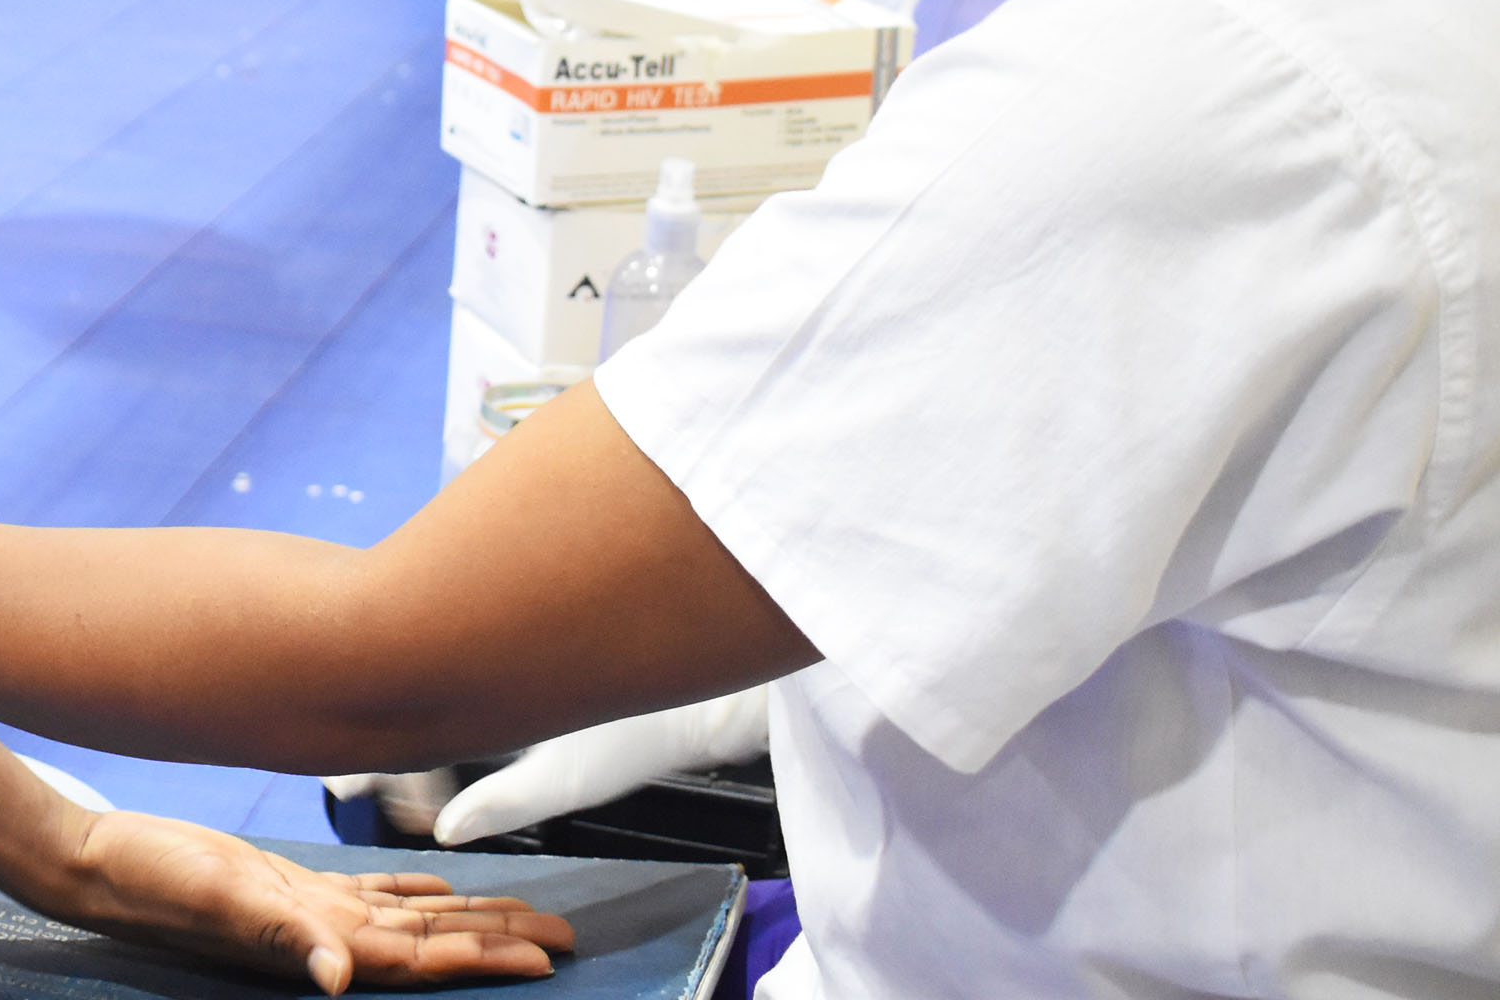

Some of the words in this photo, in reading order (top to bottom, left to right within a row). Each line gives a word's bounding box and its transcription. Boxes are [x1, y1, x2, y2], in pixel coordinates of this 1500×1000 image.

[555, 53, 676, 81] Accu-Tell
[551, 89, 618, 110] RAPID
[626, 87, 664, 108] HIV
